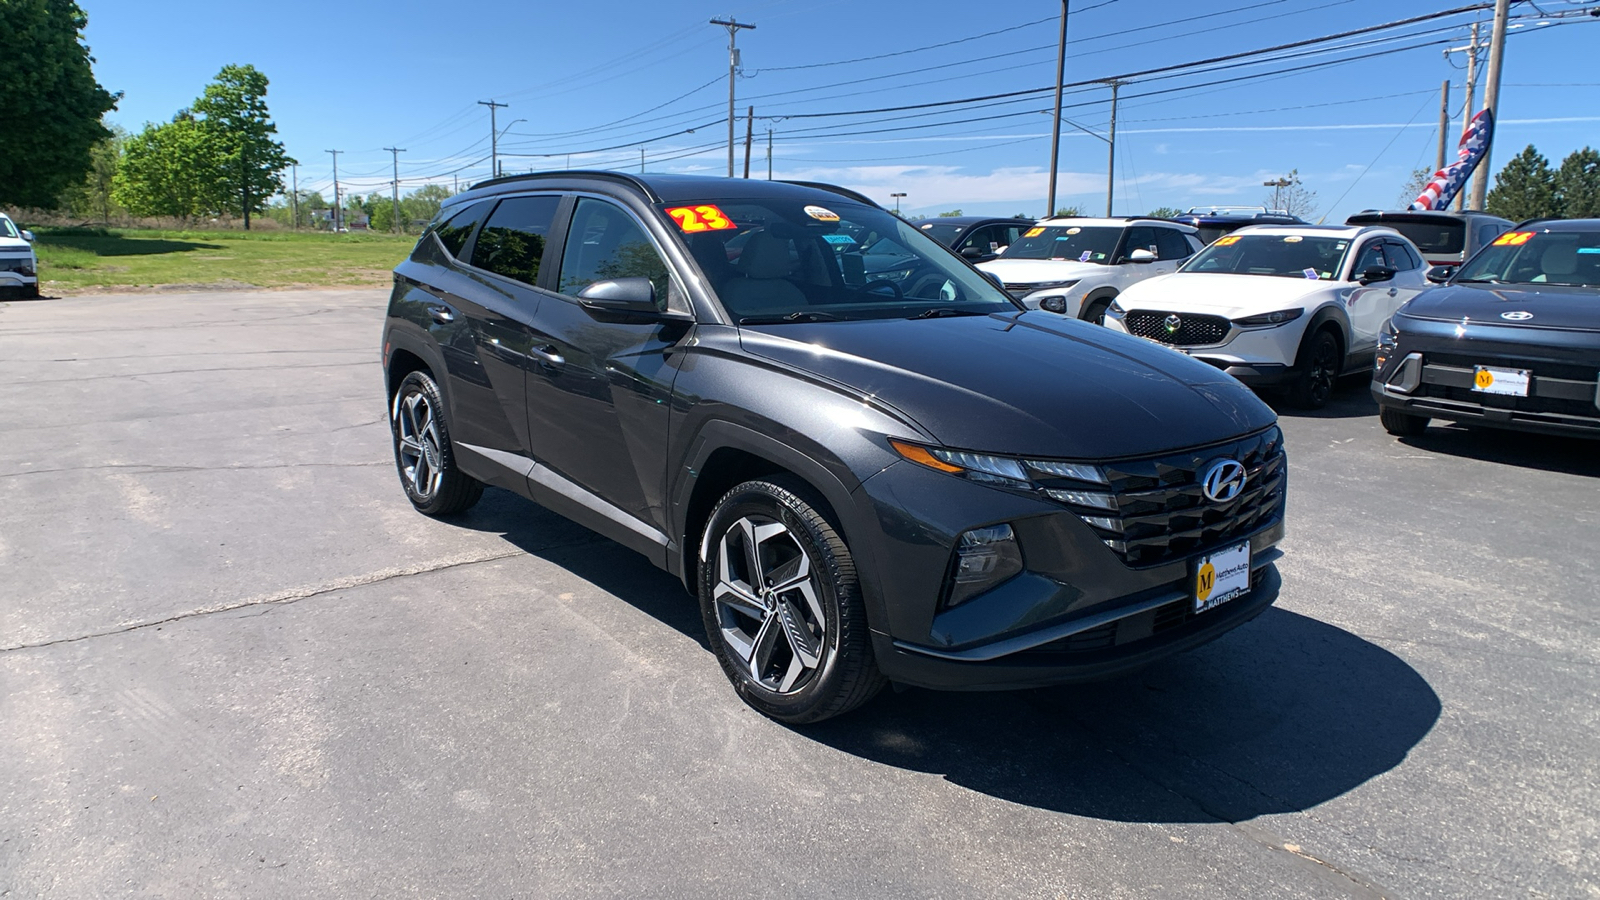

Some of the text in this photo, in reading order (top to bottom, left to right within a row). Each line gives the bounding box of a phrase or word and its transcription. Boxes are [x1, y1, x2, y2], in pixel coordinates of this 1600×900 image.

[670, 206, 730, 230] 23
[1493, 232, 1532, 245] 26
[1479, 375, 1490, 384] M
[1216, 567, 1236, 579] Matthews
[1199, 570, 1213, 593] M
[1207, 589, 1239, 609] MATTHEWS
